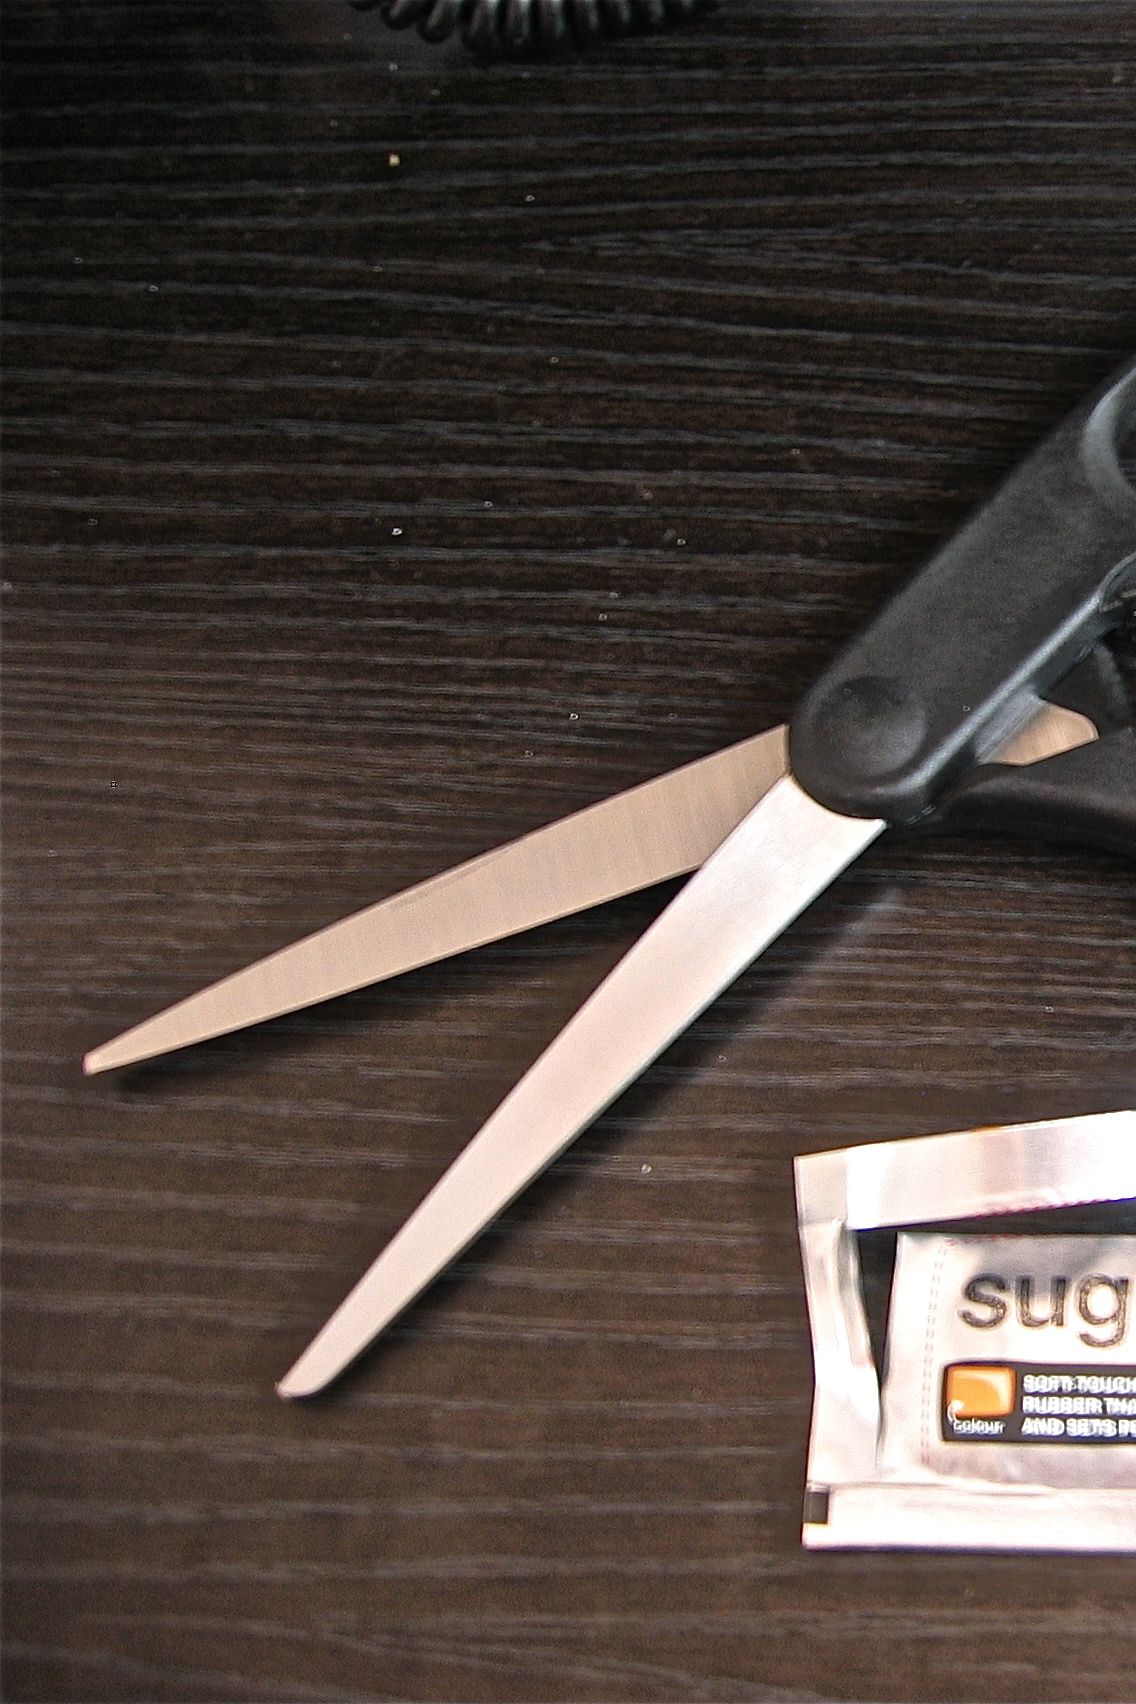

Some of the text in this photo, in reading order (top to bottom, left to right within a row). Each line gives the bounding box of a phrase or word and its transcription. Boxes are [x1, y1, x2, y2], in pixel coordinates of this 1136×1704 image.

[1022, 1396, 1103, 1416] RUBBER
[952, 1417, 1005, 1434] colour
[1021, 1417, 1064, 1437] AND
[1066, 1418, 1118, 1438] SETS
